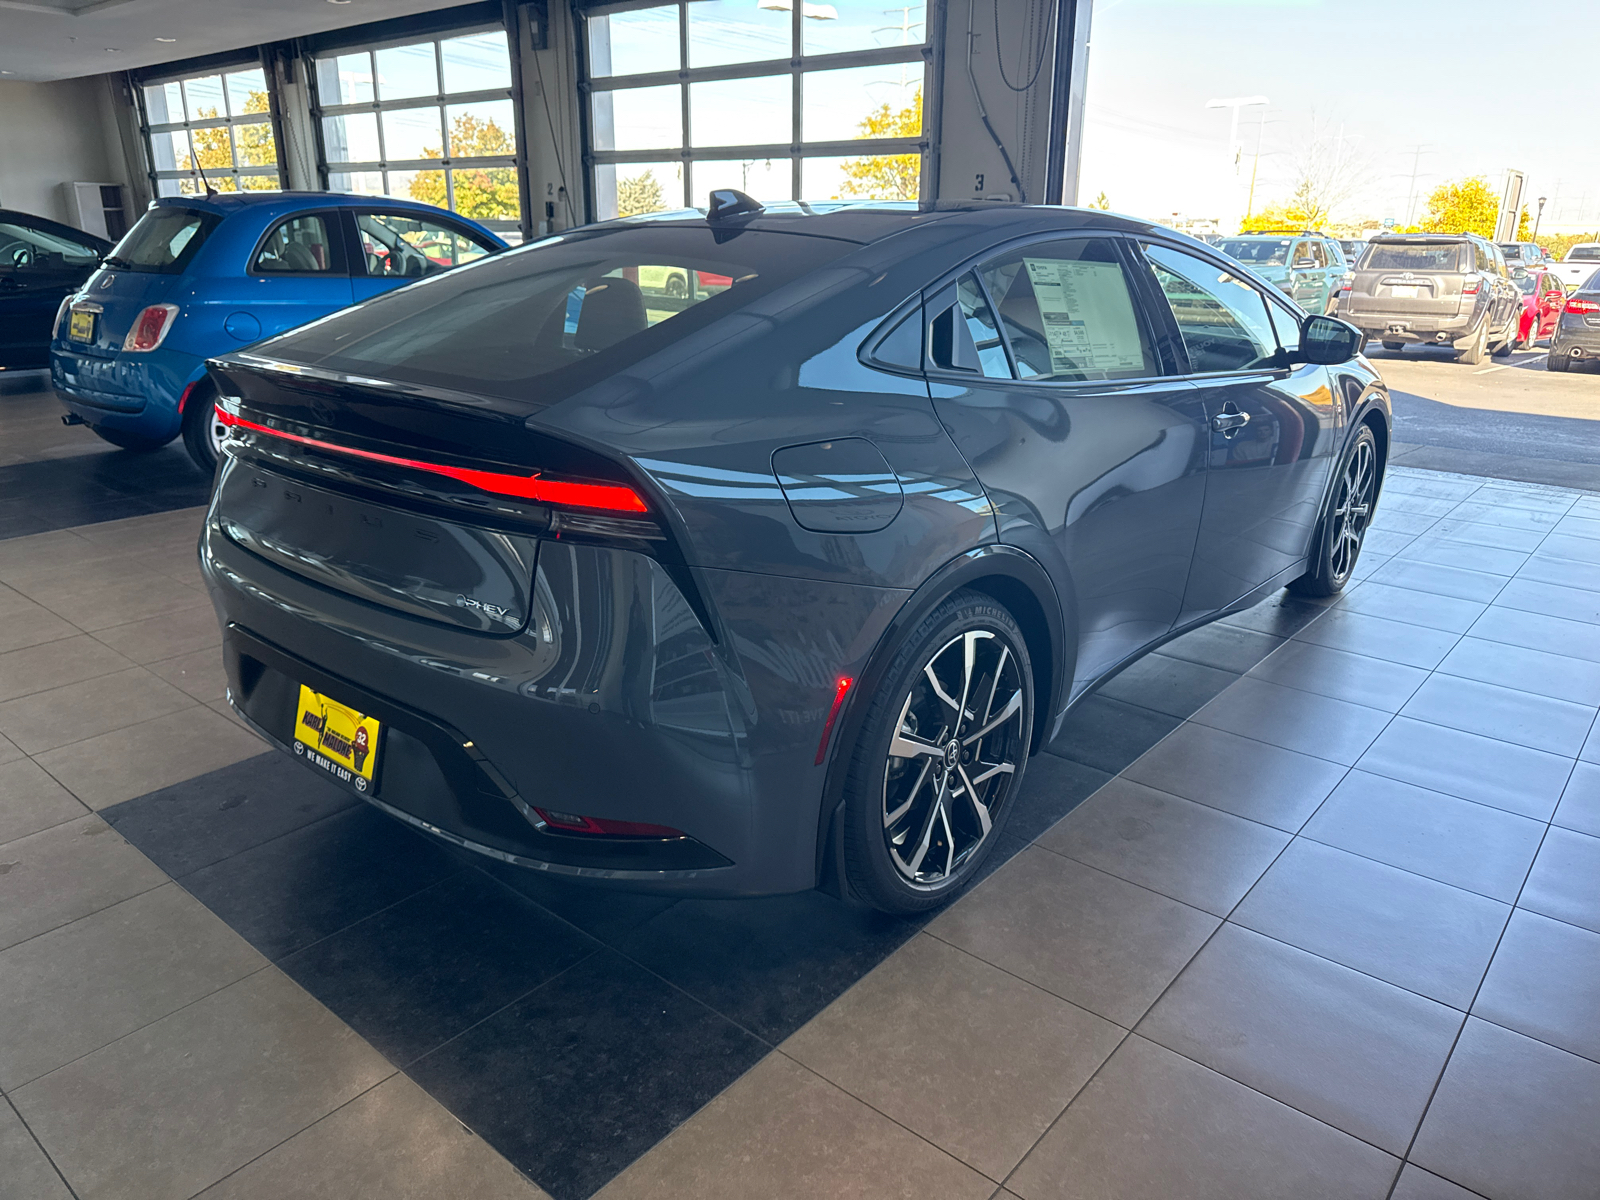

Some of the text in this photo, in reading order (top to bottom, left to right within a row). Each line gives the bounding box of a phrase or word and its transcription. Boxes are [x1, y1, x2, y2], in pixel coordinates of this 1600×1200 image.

[547, 183, 553, 195] 2
[975, 174, 984, 191] 3
[465, 598, 510, 616] PHEV
[974, 606, 1017, 632] MICHELIN
[322, 731, 352, 760] MALONE
[356, 731, 367, 746] 32
[307, 749, 352, 783] WE MAKE IT EASY
